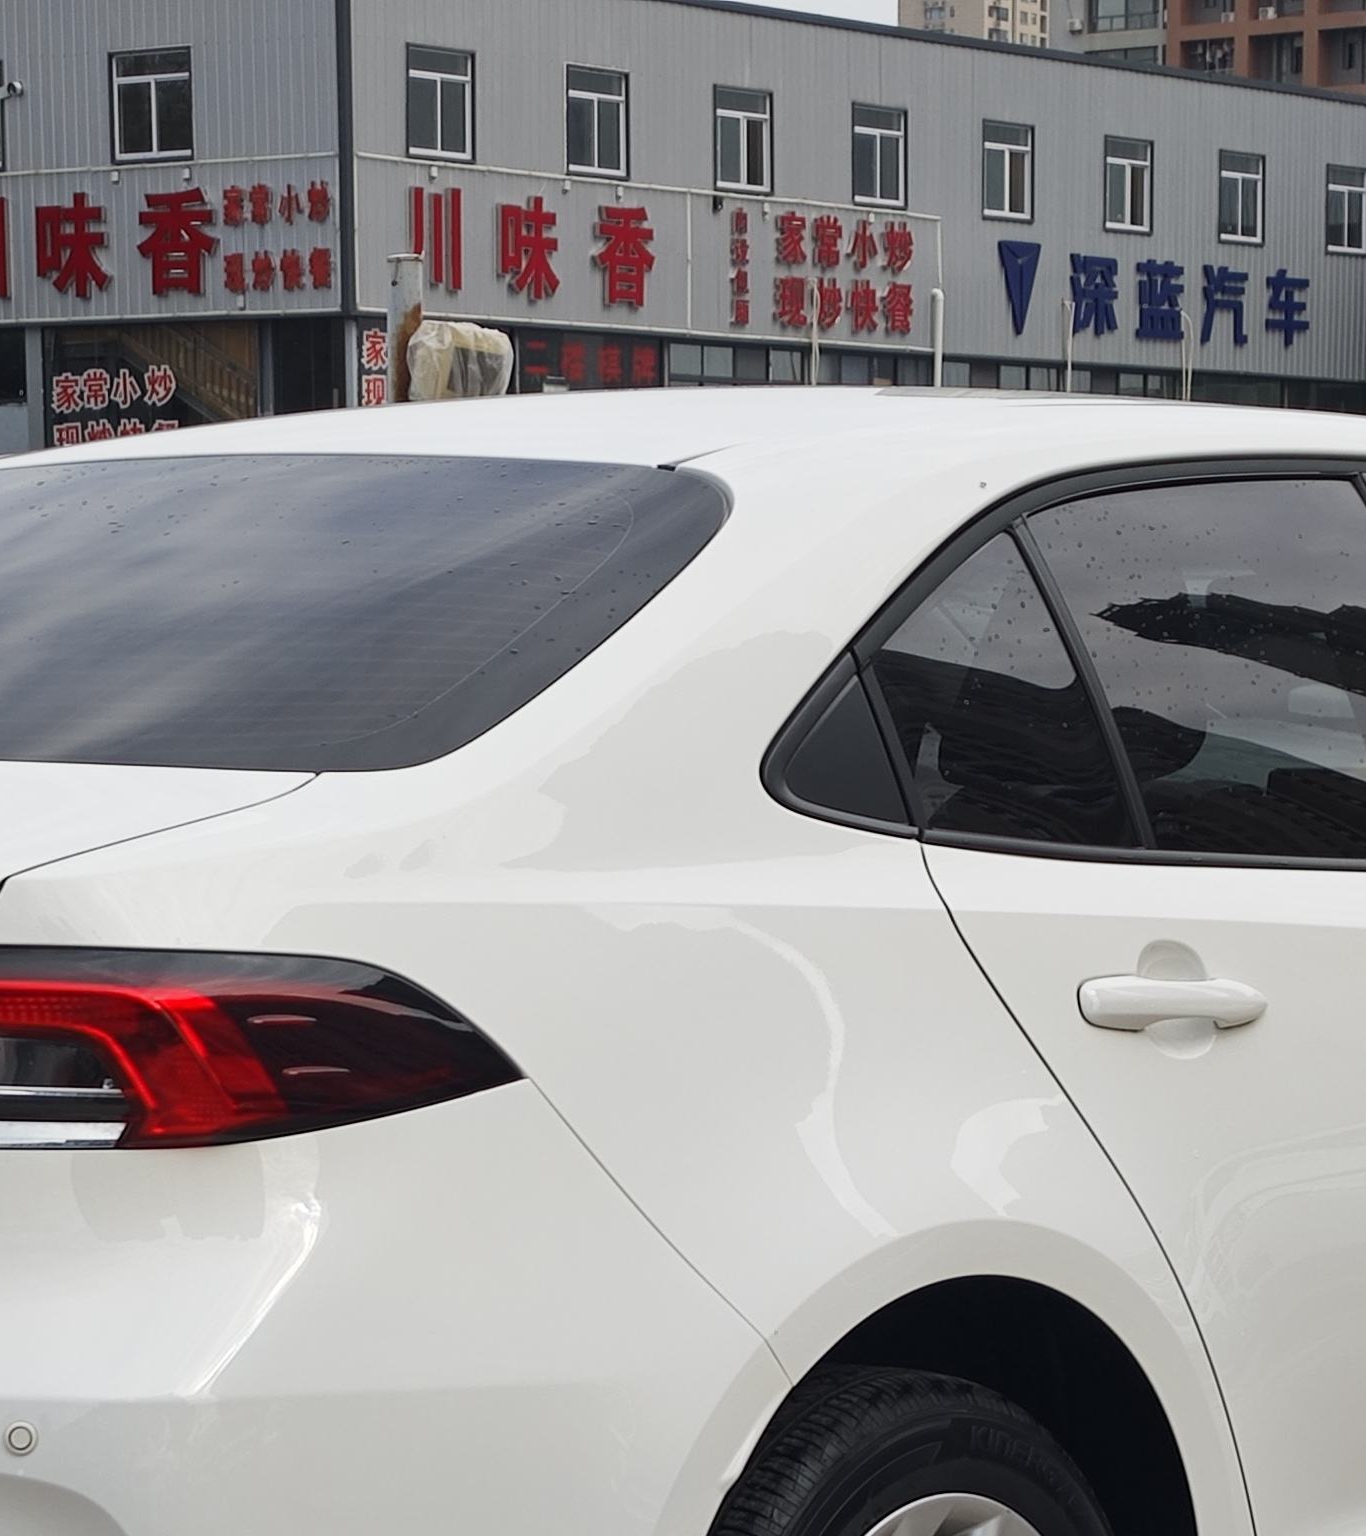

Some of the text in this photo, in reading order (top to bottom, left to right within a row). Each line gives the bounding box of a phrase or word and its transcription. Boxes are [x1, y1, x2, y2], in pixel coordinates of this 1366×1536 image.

[223, 180, 331, 226] 家常小炒
[224, 247, 333, 295] 现炒快餐
[409, 186, 656, 309] 川味香
[776, 210, 914, 275] 家常小炒
[774, 275, 914, 335] 现炒快餐
[1069, 253, 1310, 348] 深蓝汽车
[51, 365, 176, 413] 家常小炒
